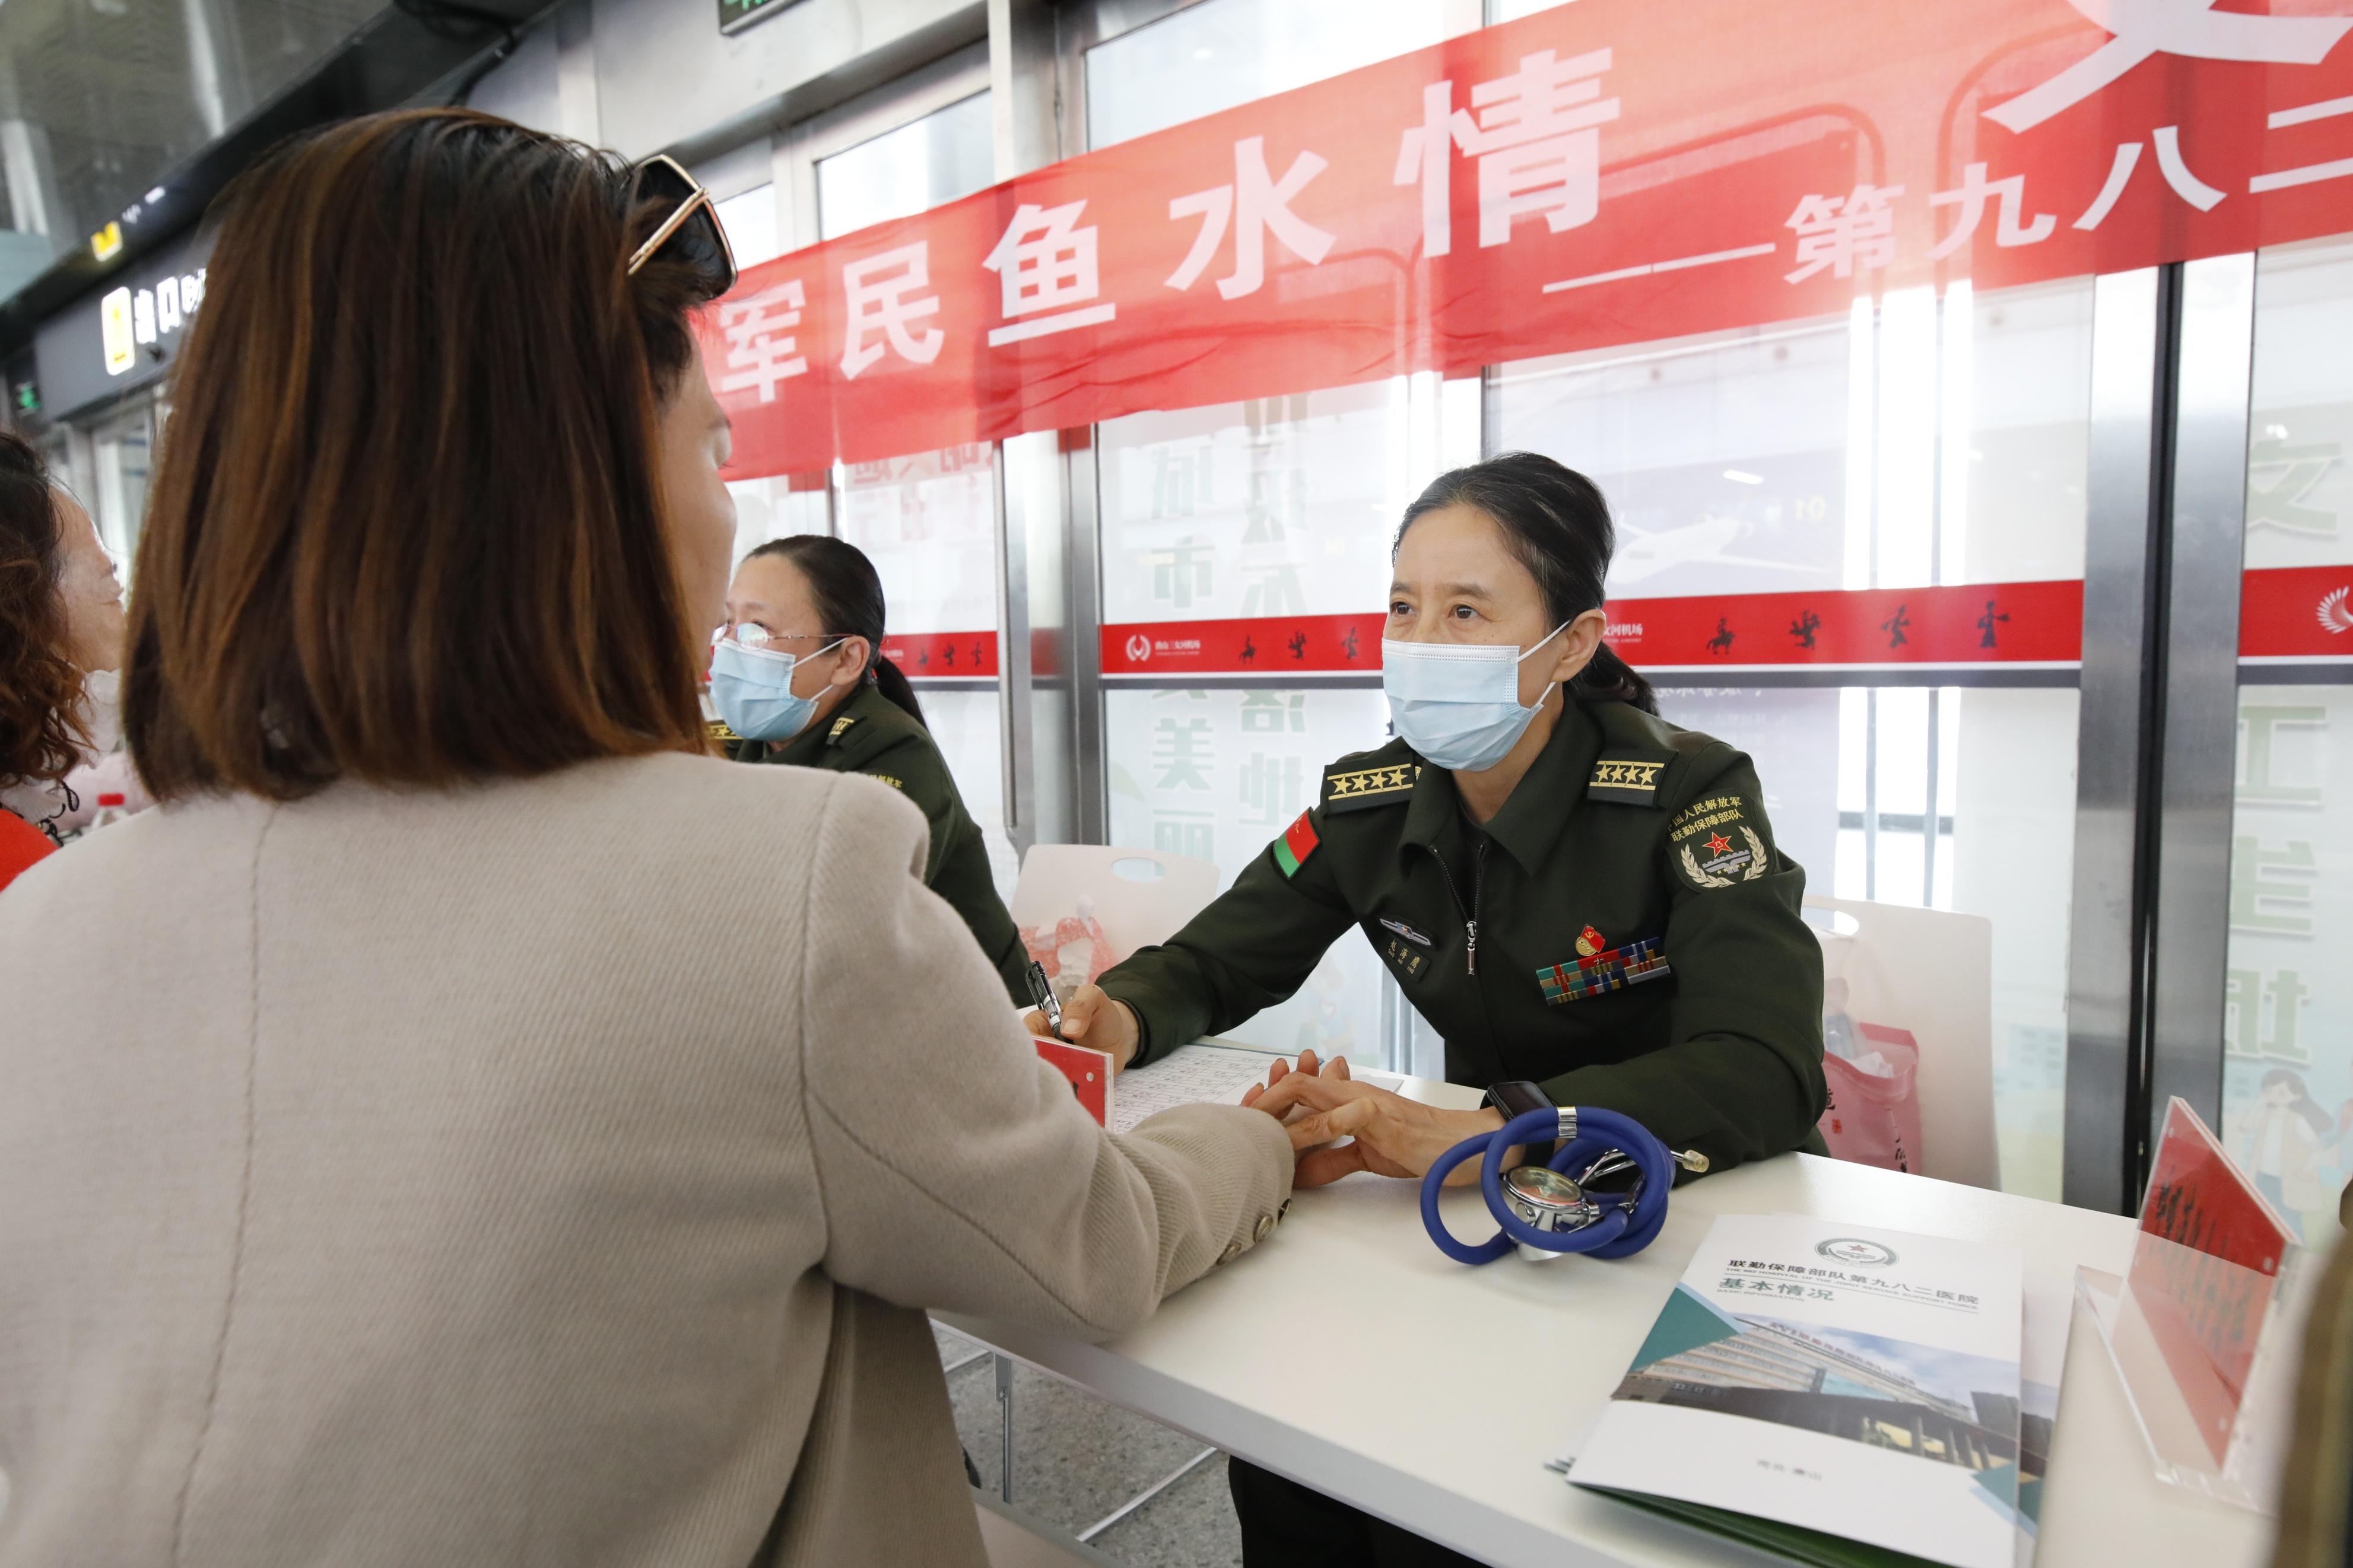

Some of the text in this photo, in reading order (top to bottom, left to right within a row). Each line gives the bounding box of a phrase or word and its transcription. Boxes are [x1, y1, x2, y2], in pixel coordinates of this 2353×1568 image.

[719, 47, 1621, 403] 军民鱼水情
[1671, 809, 1744, 842] 联勤保障部队
[1719, 1277, 1835, 1301] 基本情况
[1728, 1260, 1979, 1305] 联勤保障部队第九八二医院
[1759, 1271, 1799, 1279] HOSPITAL
[1744, 1290, 1805, 1302] INFORMATION
